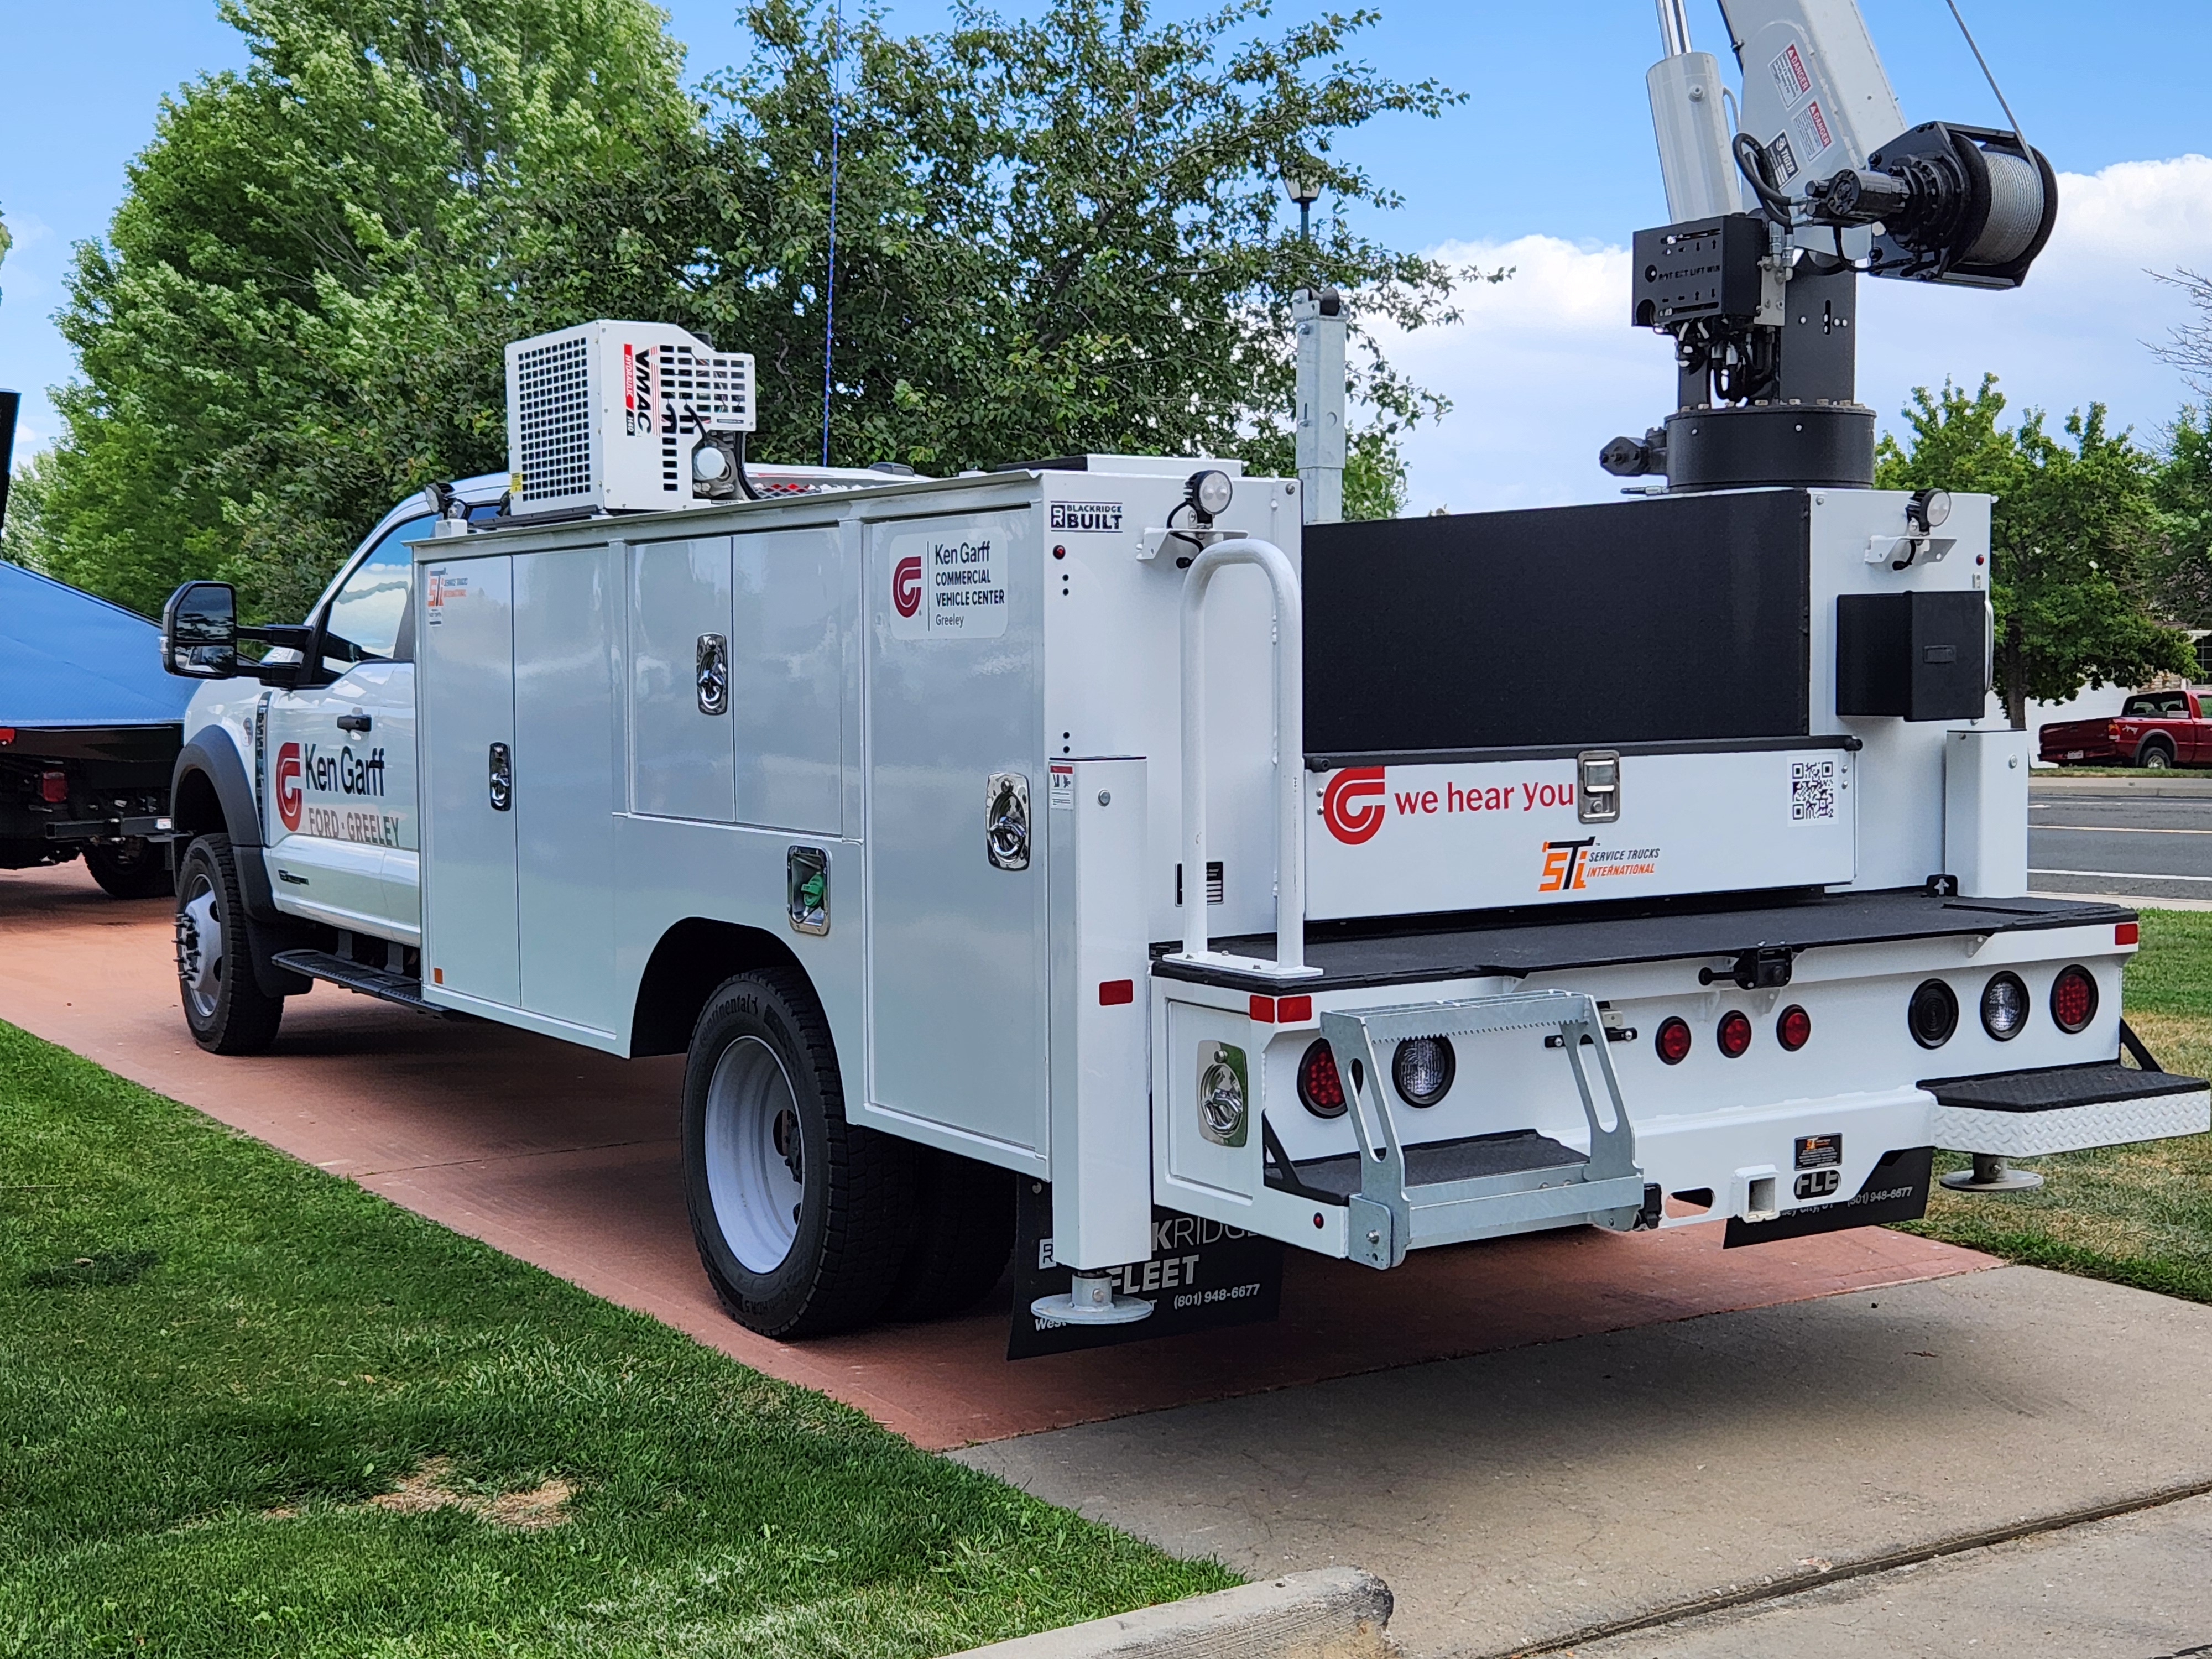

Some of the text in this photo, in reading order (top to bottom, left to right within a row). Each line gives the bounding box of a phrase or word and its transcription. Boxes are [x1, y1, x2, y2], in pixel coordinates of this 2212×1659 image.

[1791, 56, 1808, 91] DANGER
[1813, 112, 1829, 146] DANGER
[1781, 148, 1795, 173] TIGER
[1690, 267, 1705, 276] LIFT
[625, 354, 634, 398] HYDRAULIC
[635, 349, 652, 434] VMAC
[1067, 513, 1123, 529] BUILT
[935, 540, 990, 565] Ken Garff
[936, 568, 991, 586] COMMERCIAL
[936, 589, 1005, 607] VEHICLE CENTER
[936, 613, 964, 628] Greeley
[305, 743, 338, 792] Ken
[341, 745, 385, 797] Garff
[1394, 781, 1574, 815] we hear you
[308, 807, 399, 847] FORD GREELEY
[1589, 848, 1660, 863] SERVICE TRUCKS
[1587, 863, 1655, 878] INTERNATIONAL
[1105, 1254, 1199, 1295] FLEET
[1174, 1291, 1202, 1310] (801)
[1204, 1283, 1260, 1303] 948-6677
